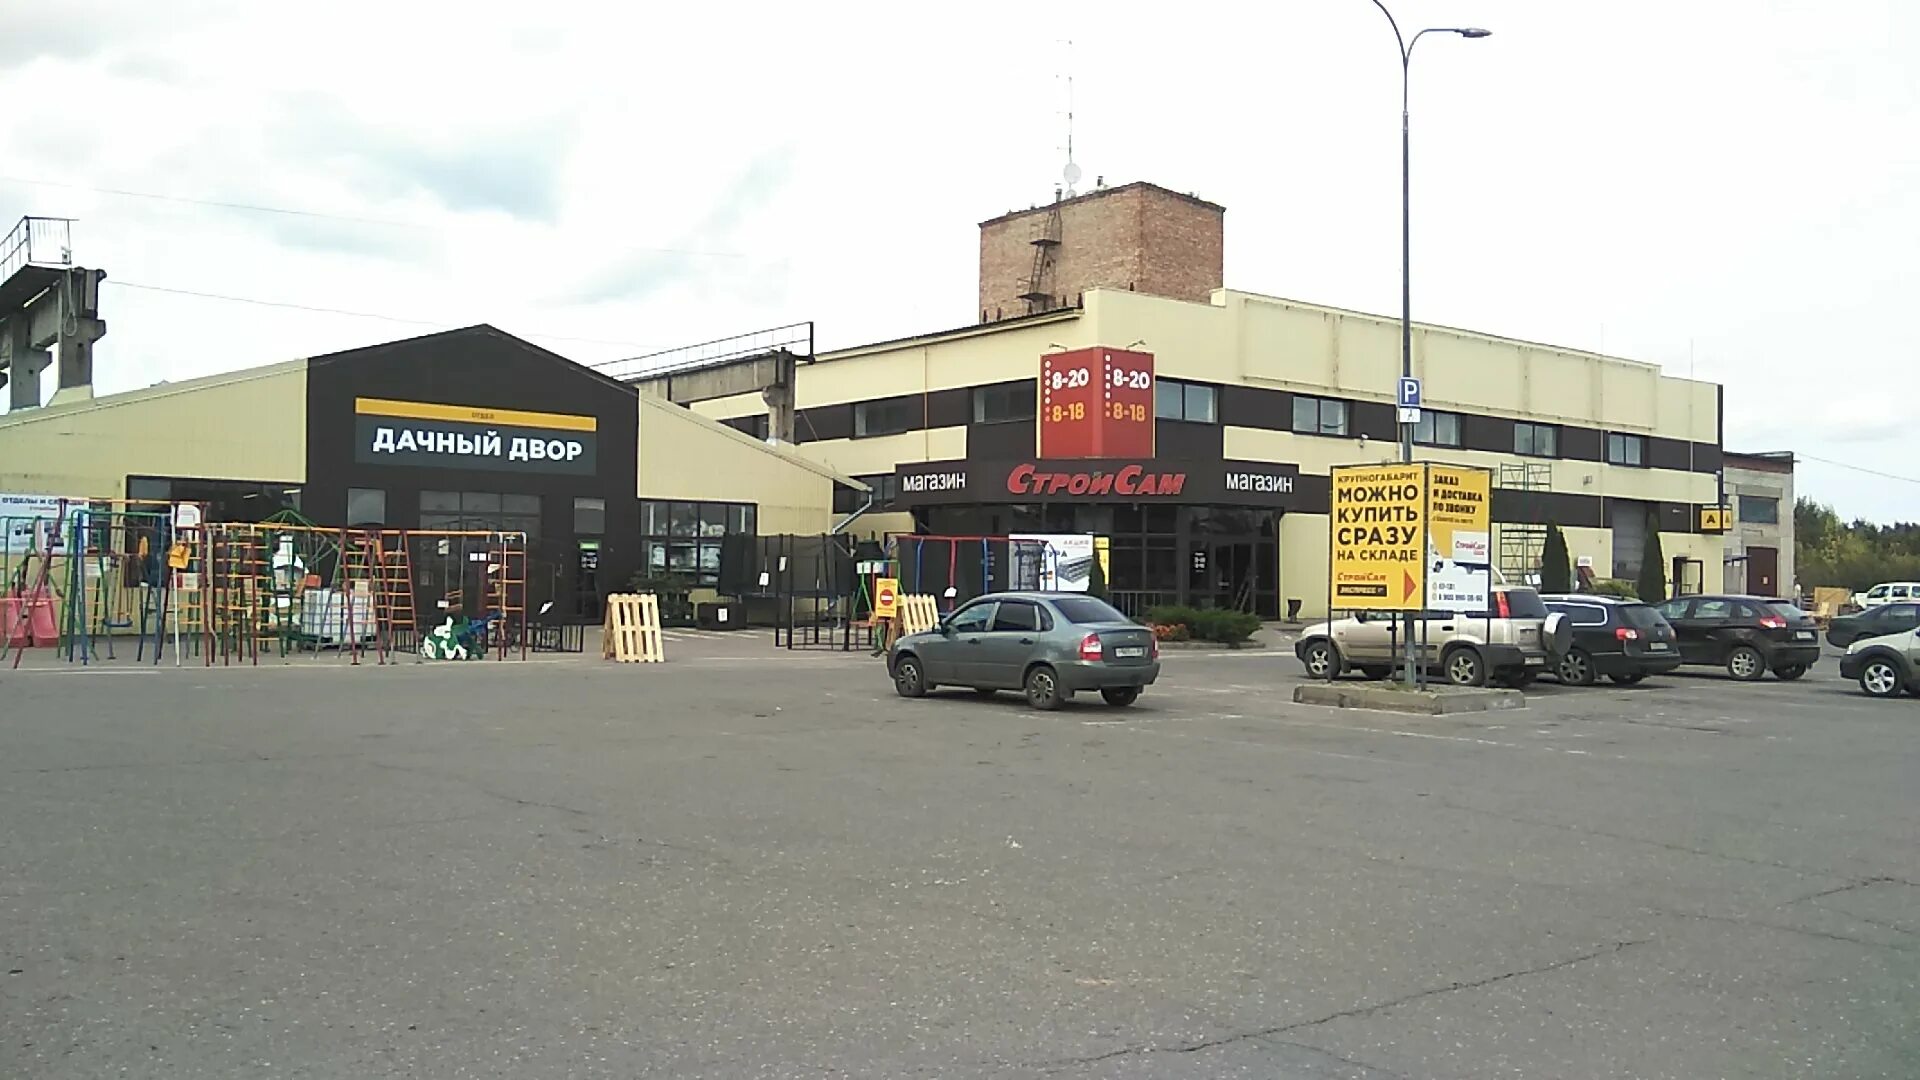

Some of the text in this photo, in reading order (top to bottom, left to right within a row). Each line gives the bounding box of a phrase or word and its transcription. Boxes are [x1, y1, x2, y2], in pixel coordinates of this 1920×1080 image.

[1052, 368, 1090, 390] 8-20
[1112, 368, 1151, 390] 8-20
[1404, 380, 1418, 402] P
[1051, 402, 1085, 422] 8-18
[1112, 401, 1146, 422] 8-18
[372, 426, 583, 462] ДАЧНЫЙ ДВОР
[902, 471, 966, 492] магазин
[1225, 471, 1294, 494] магазин
[1337, 472, 1418, 484] КРУПНОГАБАРИТ
[1433, 474, 1459, 486] ЗАКАЗ
[1337, 484, 1418, 503] МОЖНО
[1433, 488, 1483, 502] И ДОСТАВКА
[1337, 506, 1418, 524] КУПИТЬ
[1432, 501, 1476, 515] ПО ЗВОНКУ
[1337, 526, 1418, 546] СРАЗУ
[1337, 549, 1418, 563] НА СКЛАДЕ
